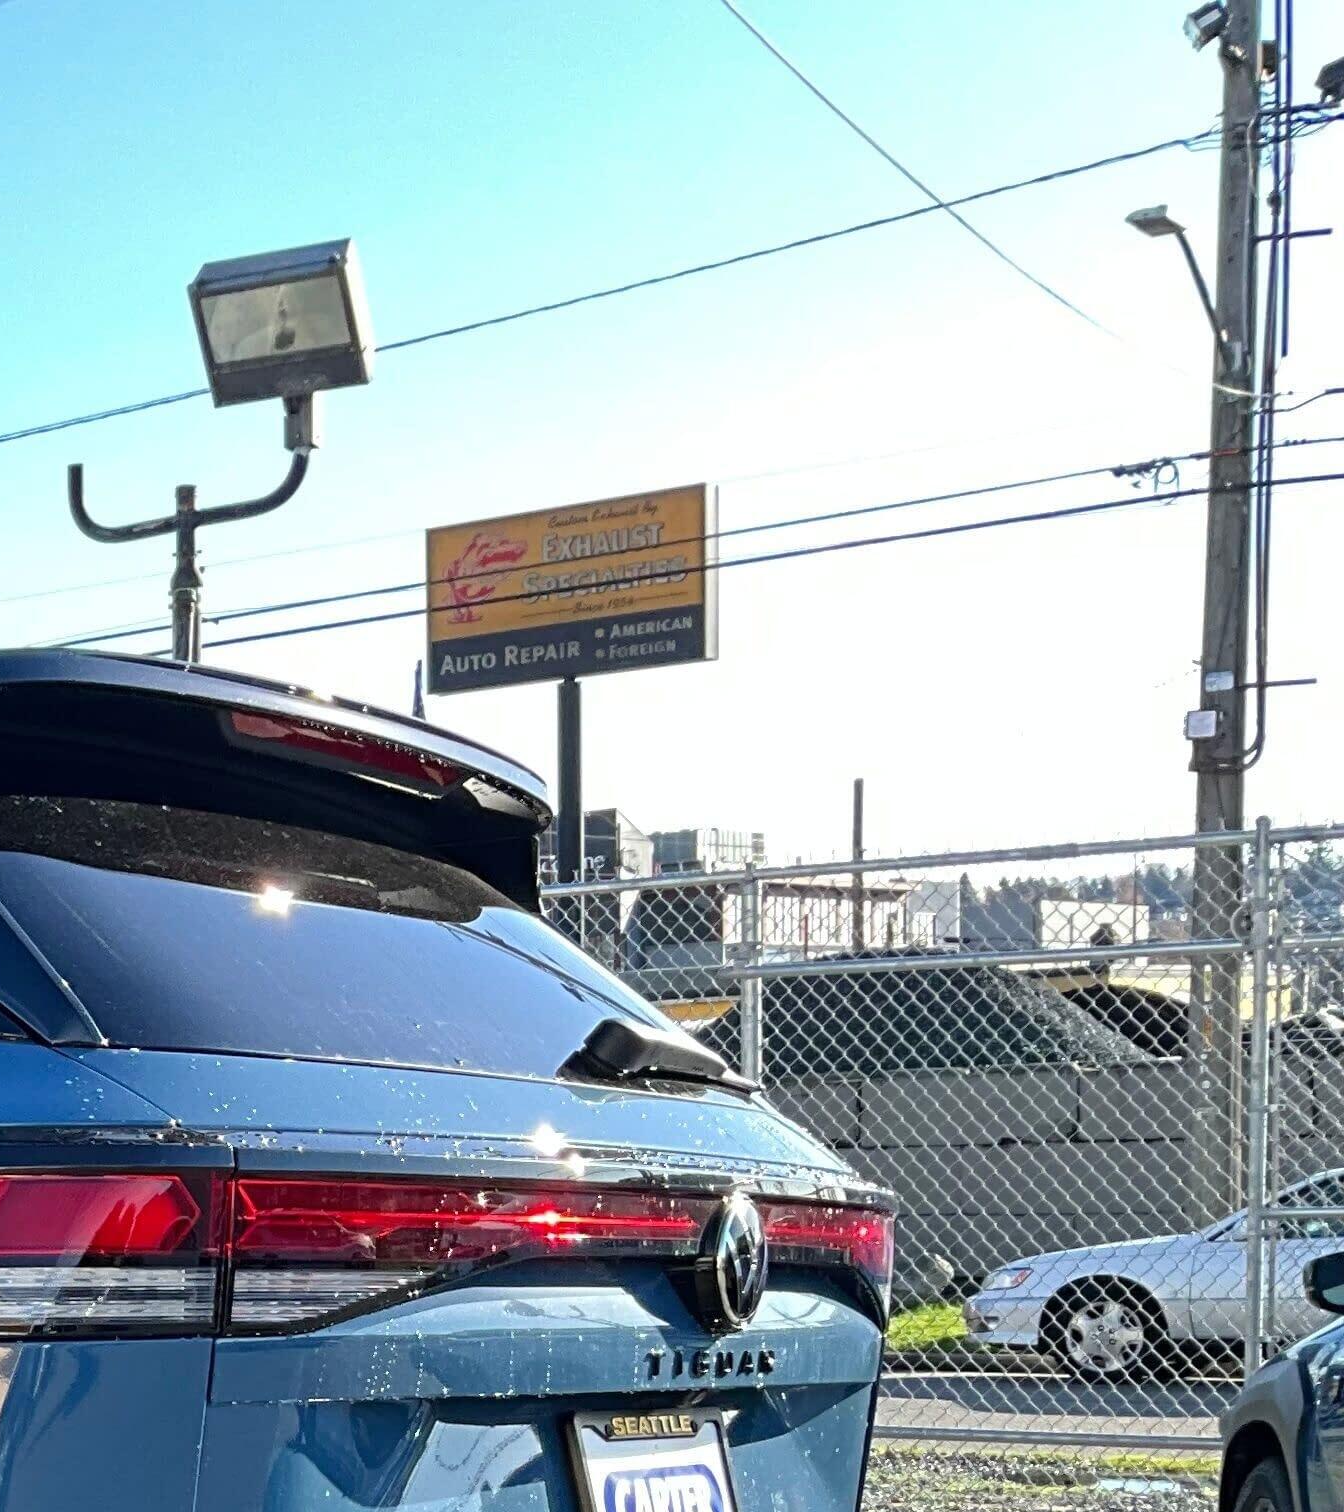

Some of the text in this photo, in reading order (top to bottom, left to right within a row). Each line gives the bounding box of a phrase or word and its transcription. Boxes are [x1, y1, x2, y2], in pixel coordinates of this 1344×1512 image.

[542, 522, 665, 562] EXHAUST
[522, 555, 688, 604] SPECIALTIES
[610, 616, 693, 639] AMERICAN
[440, 641, 580, 676] AUTO REPAIR
[609, 639, 677, 659] FOREIGN
[643, 1350, 776, 1380] TIGUAN
[611, 1414, 693, 1436] SEATTLE
